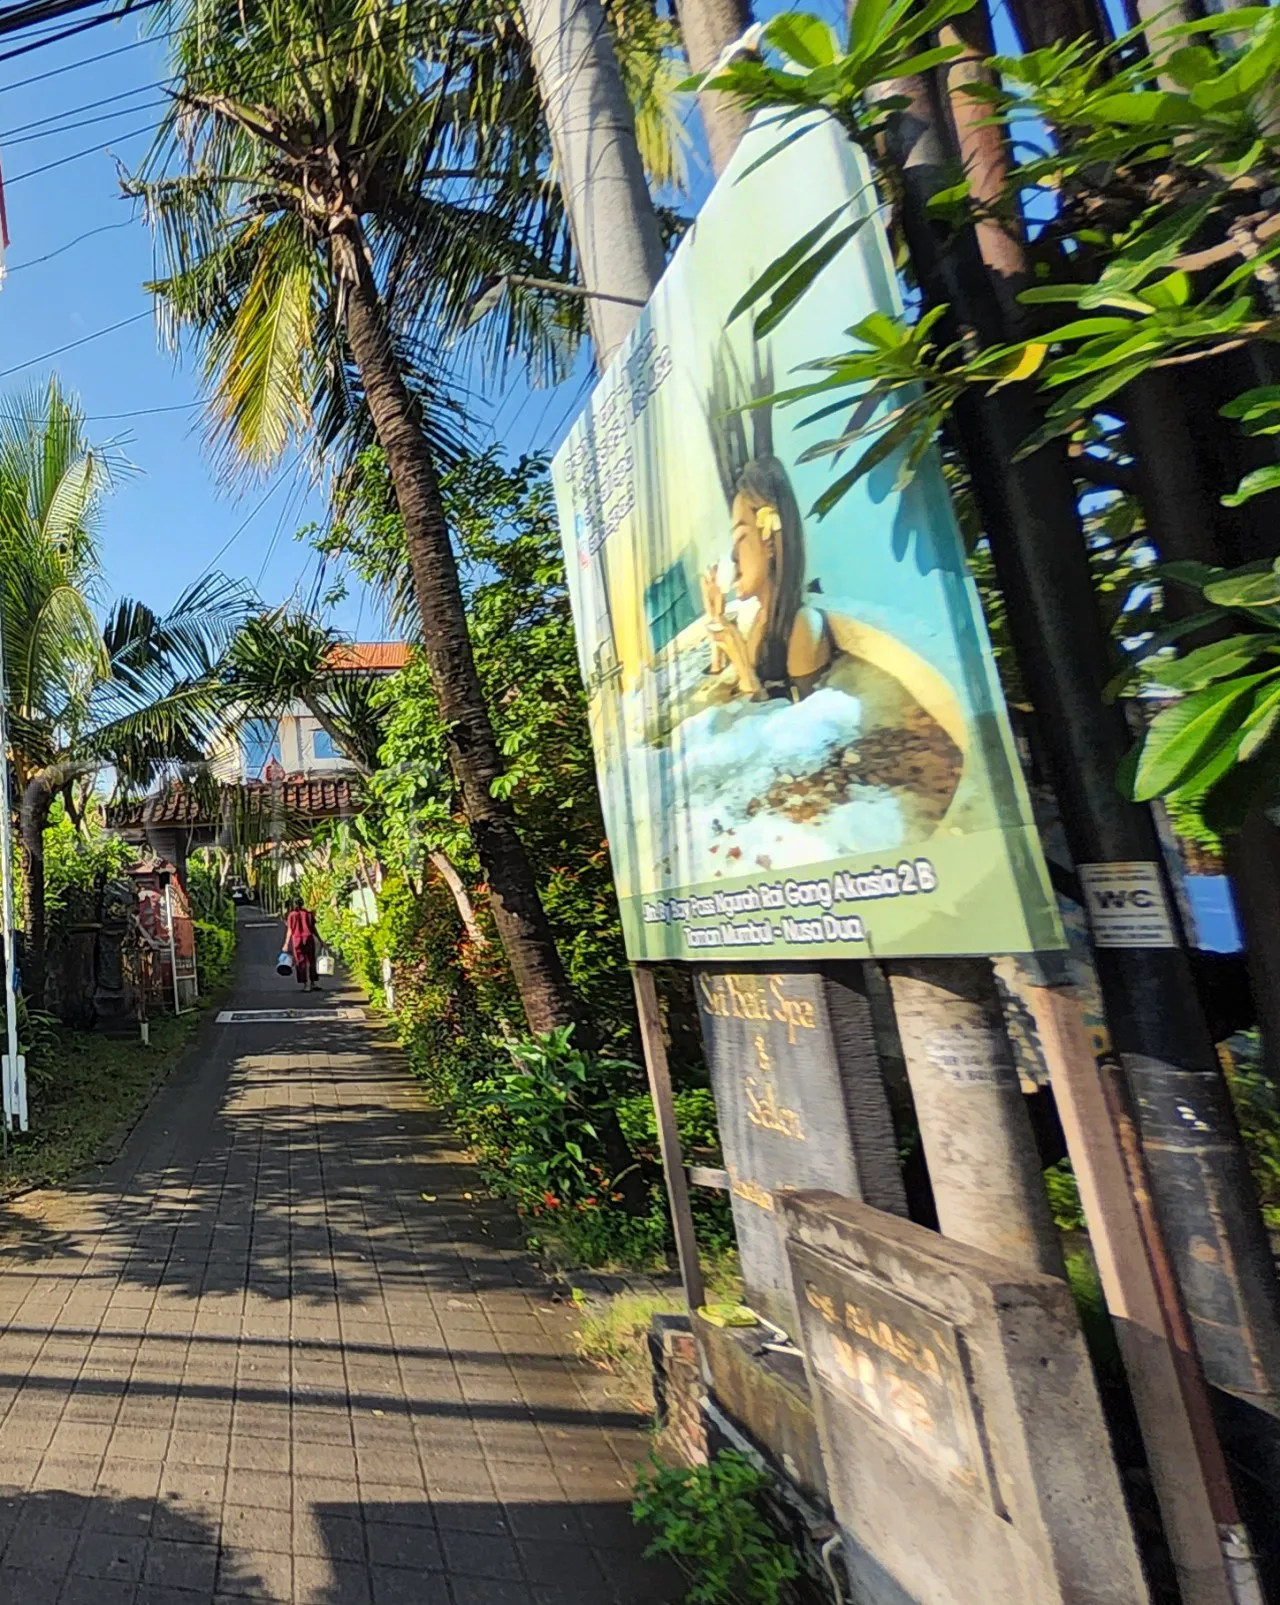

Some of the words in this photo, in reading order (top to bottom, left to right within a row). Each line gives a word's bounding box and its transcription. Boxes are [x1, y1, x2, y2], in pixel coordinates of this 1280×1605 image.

[715, 886, 761, 919] Ngurah
[760, 882, 785, 909] Rai
[783, 879, 832, 910] Gang
[831, 865, 899, 901] Akasia
[896, 860, 918, 892] 2
[916, 858, 937, 892] B
[1093, 889, 1153, 909] WC
[684, 926, 722, 948] Taman
[721, 918, 774, 946] Mumbul
[781, 915, 824, 944] Nusa
[822, 912, 865, 941] Dua
[769, 974, 815, 1045] Spa
[745, 1075, 806, 1141] Salon
